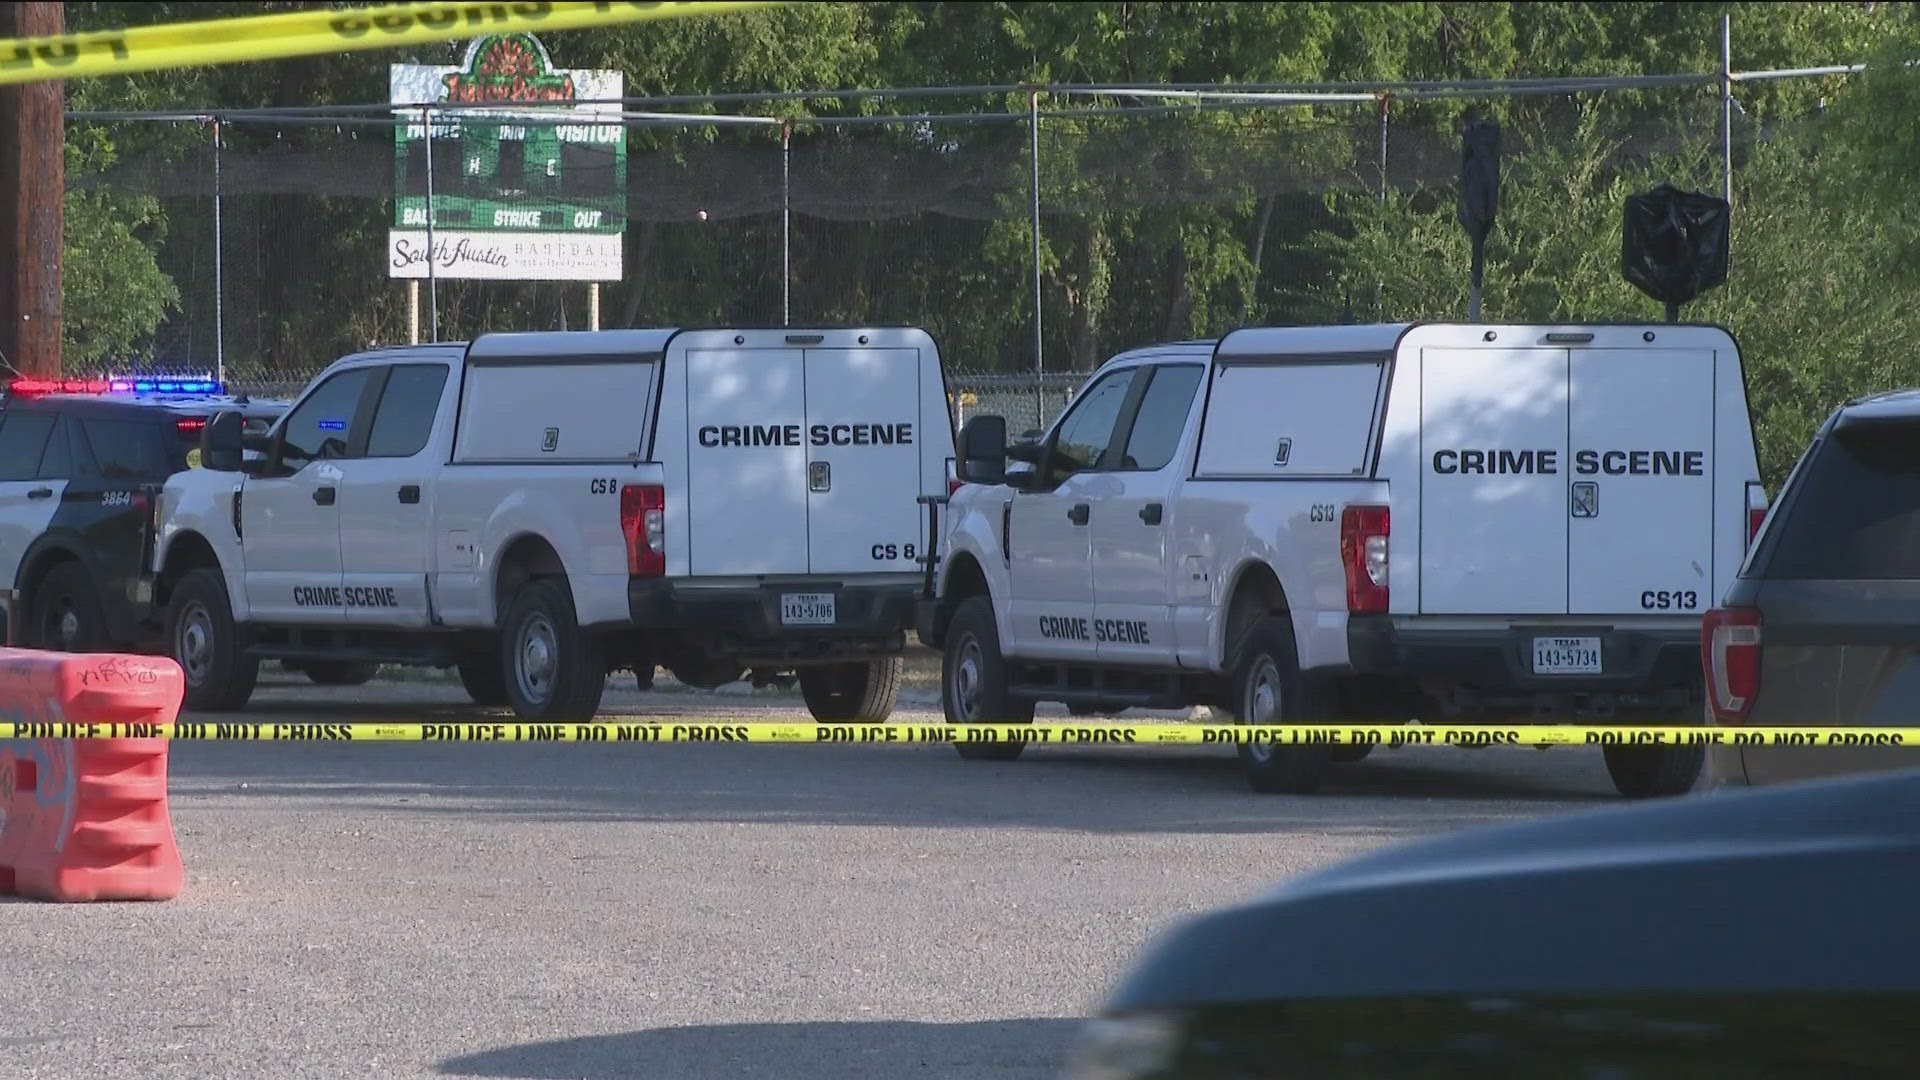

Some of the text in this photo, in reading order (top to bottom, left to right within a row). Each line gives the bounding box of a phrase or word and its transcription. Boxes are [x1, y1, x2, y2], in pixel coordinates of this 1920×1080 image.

[556, 125, 622, 143] VISITOR
[494, 209, 541, 228] STRIKE
[574, 210, 602, 228] OUT
[441, 238, 509, 268] Austin
[699, 422, 913, 448] CRIME SCENE
[1432, 449, 1704, 476] CRIME SCENE
[591, 478, 617, 494] CS 8
[101, 491, 131, 506] 3864
[1311, 504, 1335, 522] CS13
[871, 543, 916, 561] CS 8
[293, 586, 399, 608] CRIME SCENE
[1640, 590, 1698, 610] CS13
[1039, 615, 1150, 645] CRIME SCENE
[421, 724, 505, 741] POLICE
[515, 724, 566, 741] LINE
[576, 724, 607, 741] DO
[616, 724, 663, 741] NOT
[672, 724, 750, 741] CROSS
[816, 726, 898, 742] POLICE
[907, 726, 957, 742] LINE
[966, 726, 998, 742] DO
[1007, 726, 1052, 742] NOT
[1061, 726, 1137, 742] CROSS
